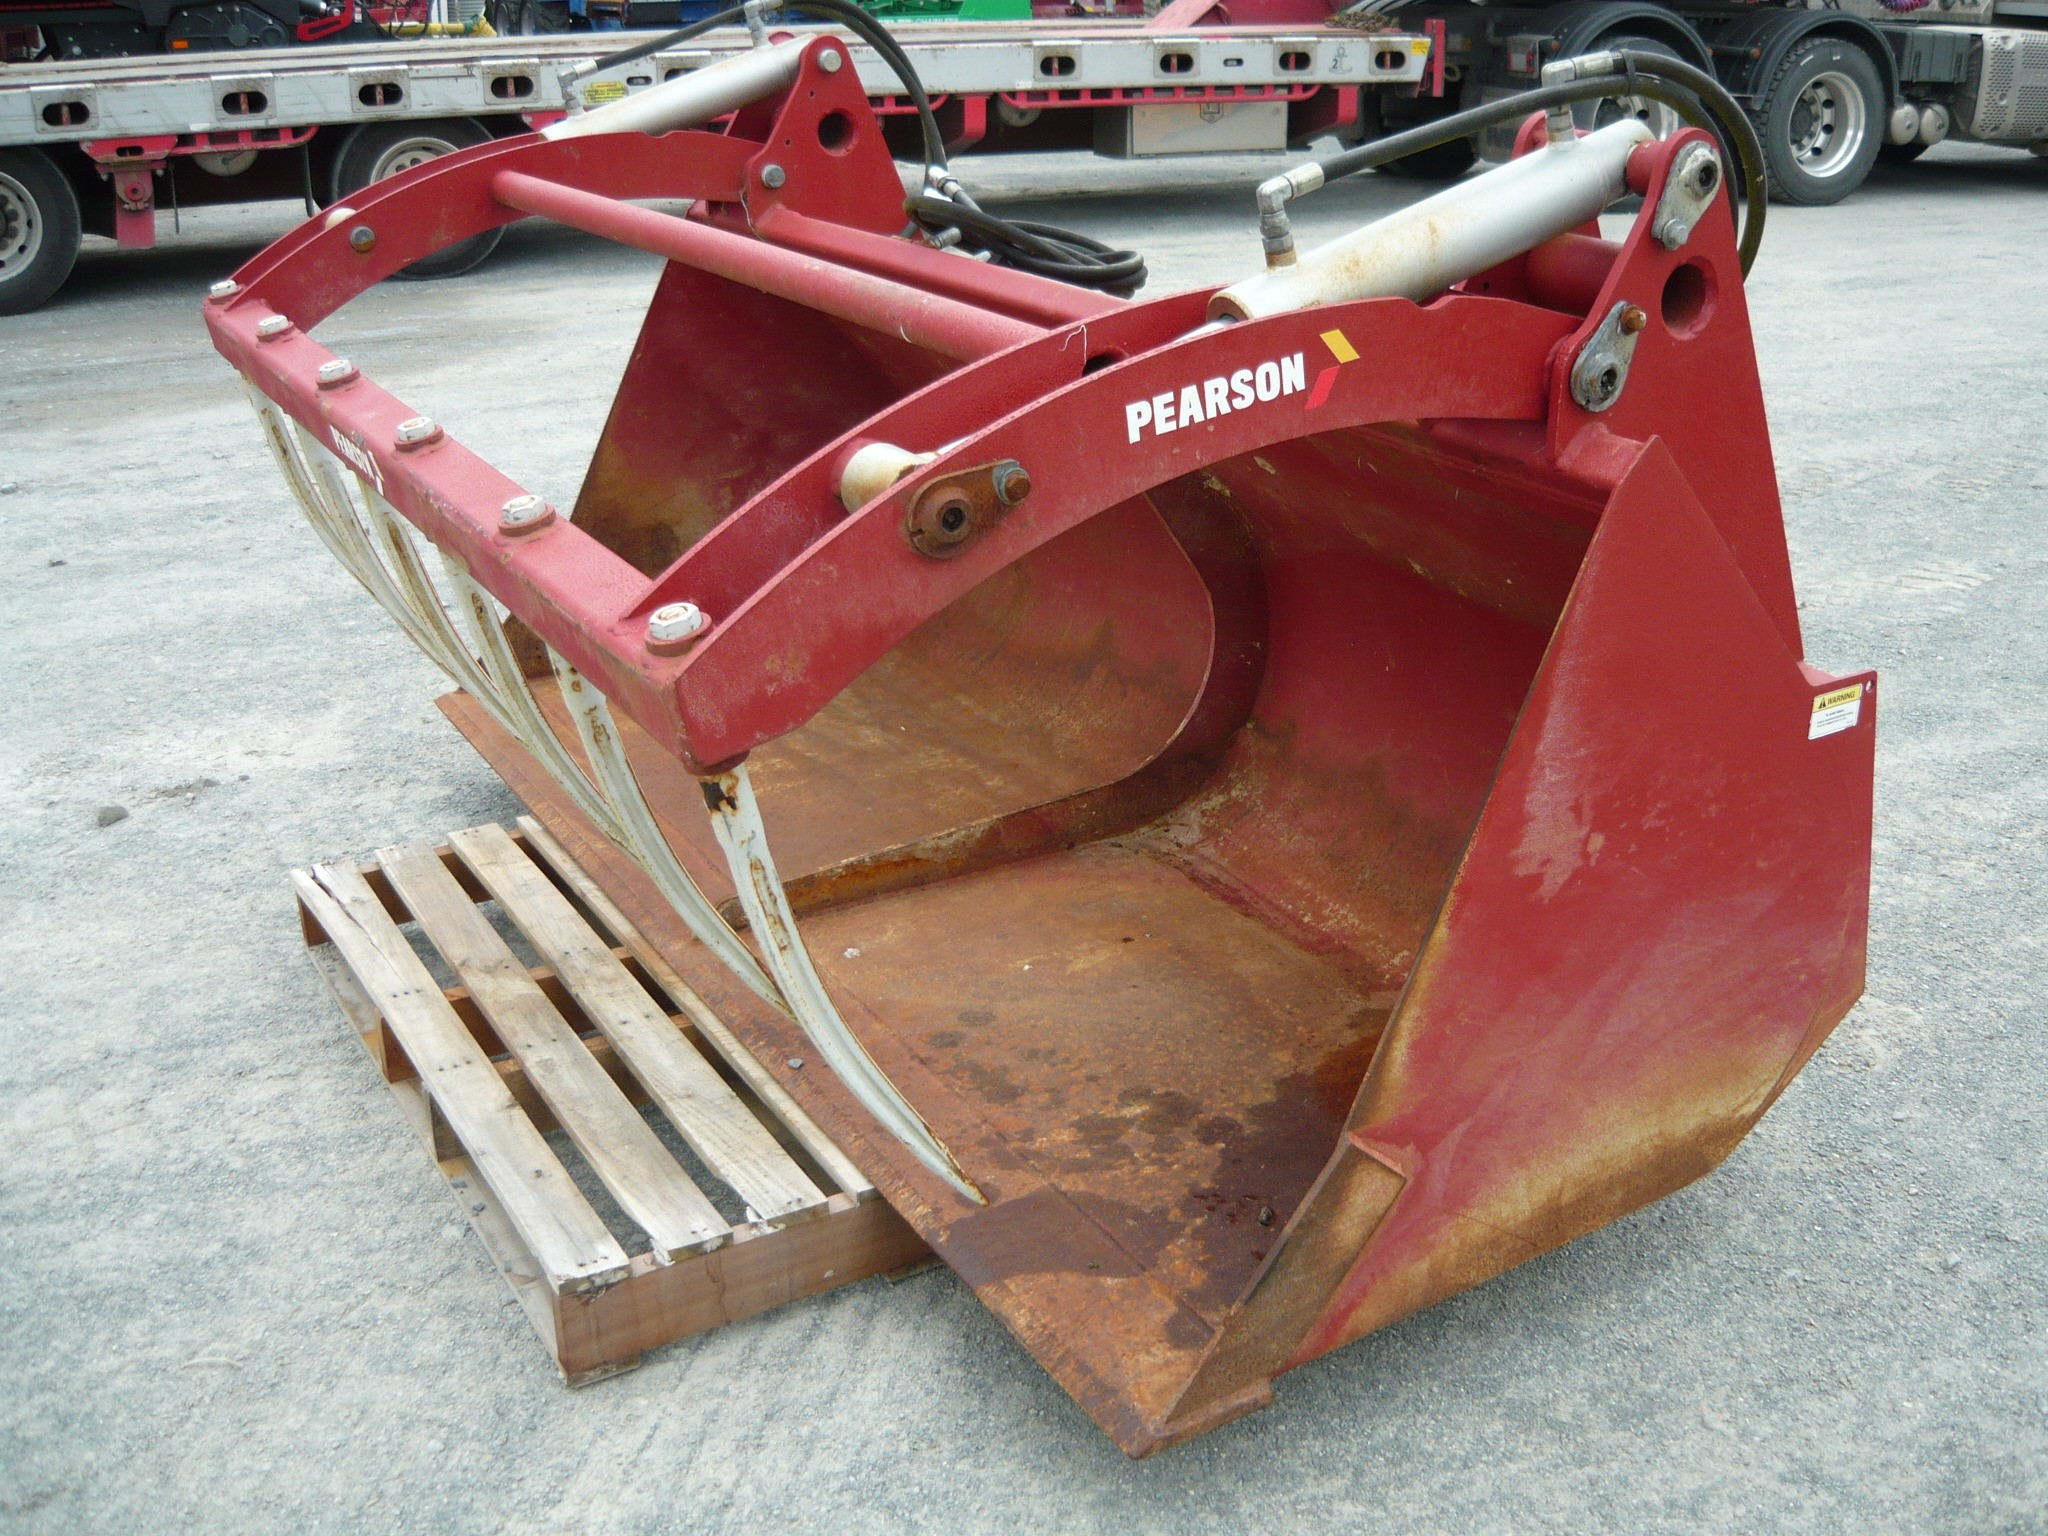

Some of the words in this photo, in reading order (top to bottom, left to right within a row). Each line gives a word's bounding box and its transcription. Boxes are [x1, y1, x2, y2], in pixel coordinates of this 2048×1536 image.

[1332, 58, 1338, 70] 2
[1125, 352, 1306, 445] PEARSON
[1827, 690, 1856, 706] WARNING
